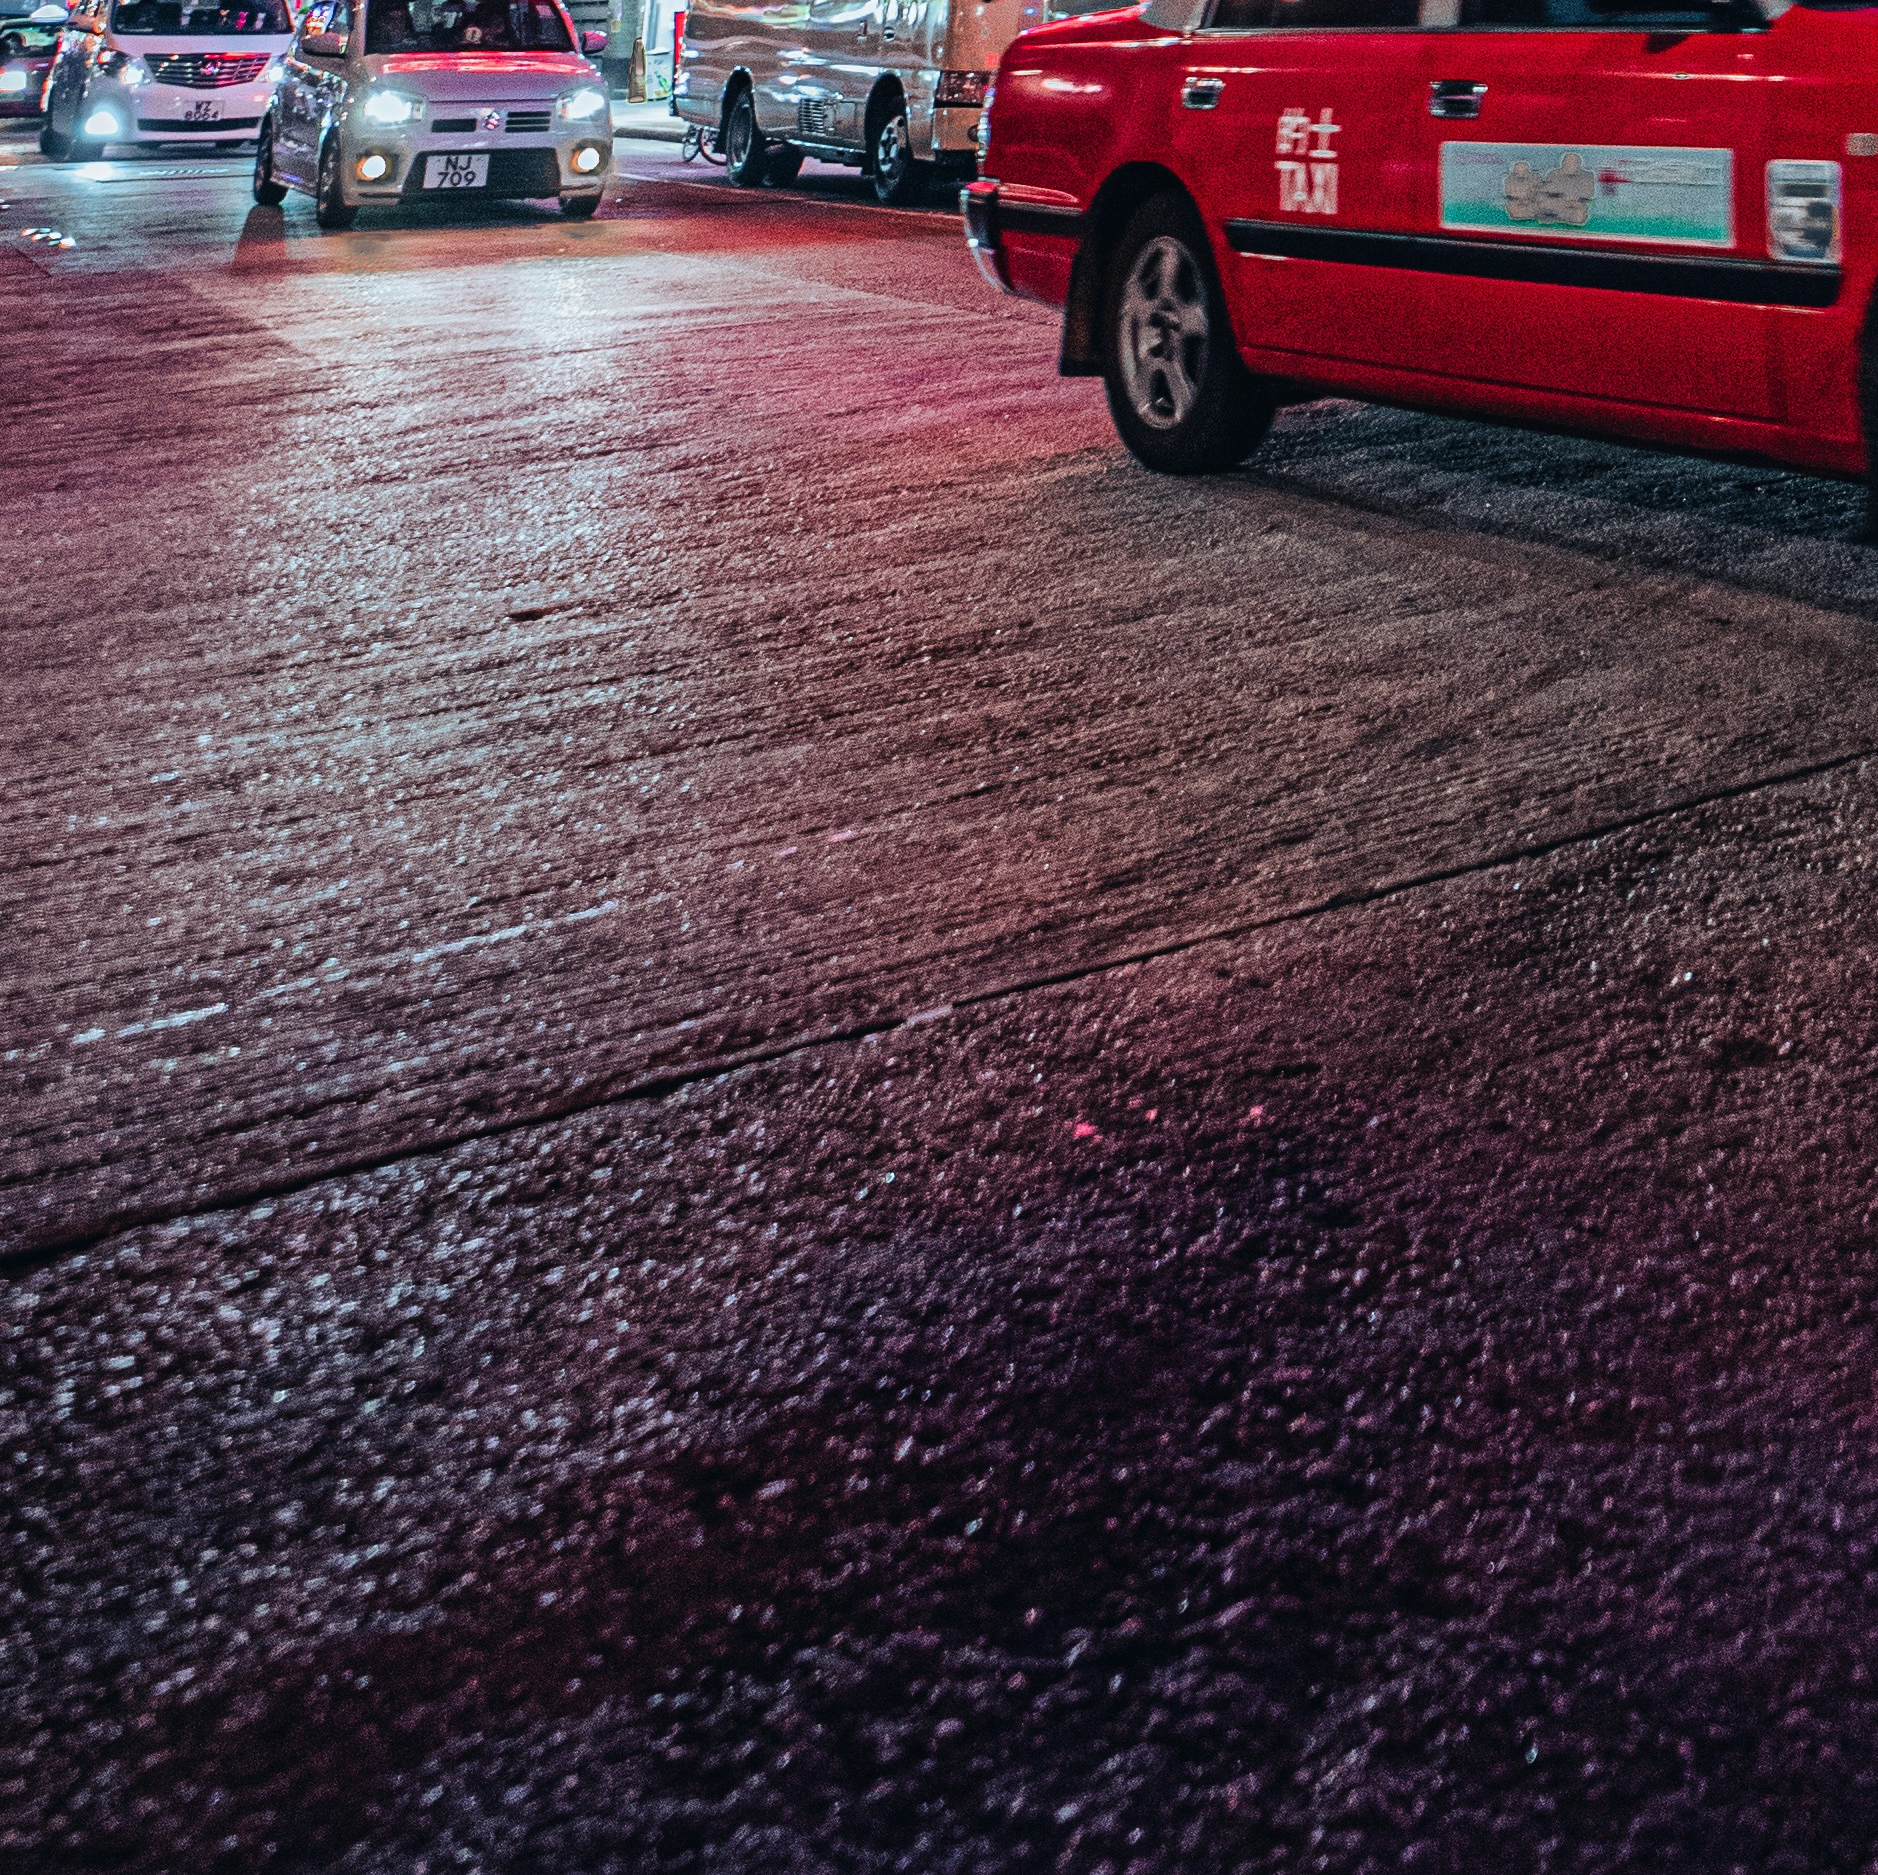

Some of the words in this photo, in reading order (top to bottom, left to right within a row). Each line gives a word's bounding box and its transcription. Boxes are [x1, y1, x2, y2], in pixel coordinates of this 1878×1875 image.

[1275, 106, 1342, 158] 的士
[437, 171, 476, 187] 709
[445, 155, 473, 171] NJ
[1273, 160, 1341, 215] TAXI
